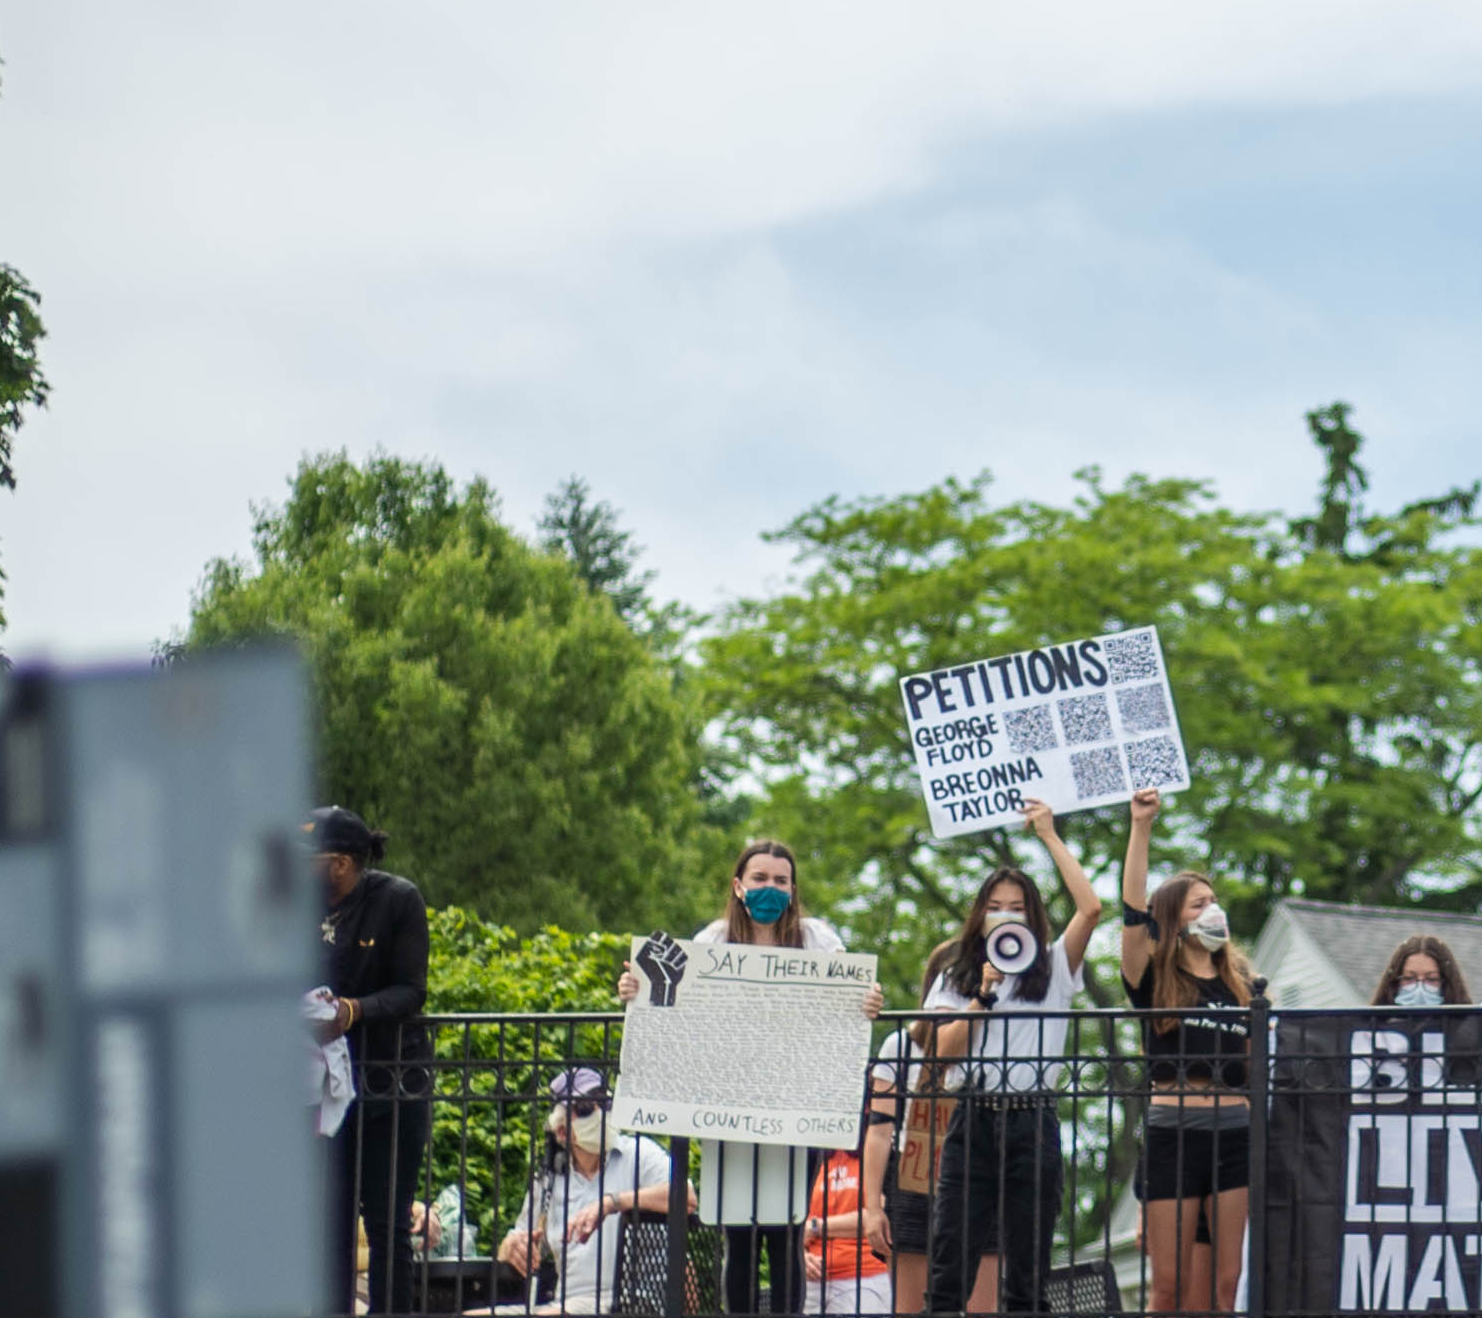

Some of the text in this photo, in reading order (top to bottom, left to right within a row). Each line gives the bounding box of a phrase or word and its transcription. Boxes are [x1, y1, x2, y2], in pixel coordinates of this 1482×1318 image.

[904, 640, 1109, 720] PETITIONS
[915, 713, 999, 748] GEORGE
[926, 738, 993, 767] FLOYD
[930, 757, 1043, 801] BREONNA
[942, 788, 1025, 823] TAYLOR
[698, 948, 873, 983] SAY THEIR NAMES
[631, 1108, 856, 1135] AND COUNTLESS OTHERS
